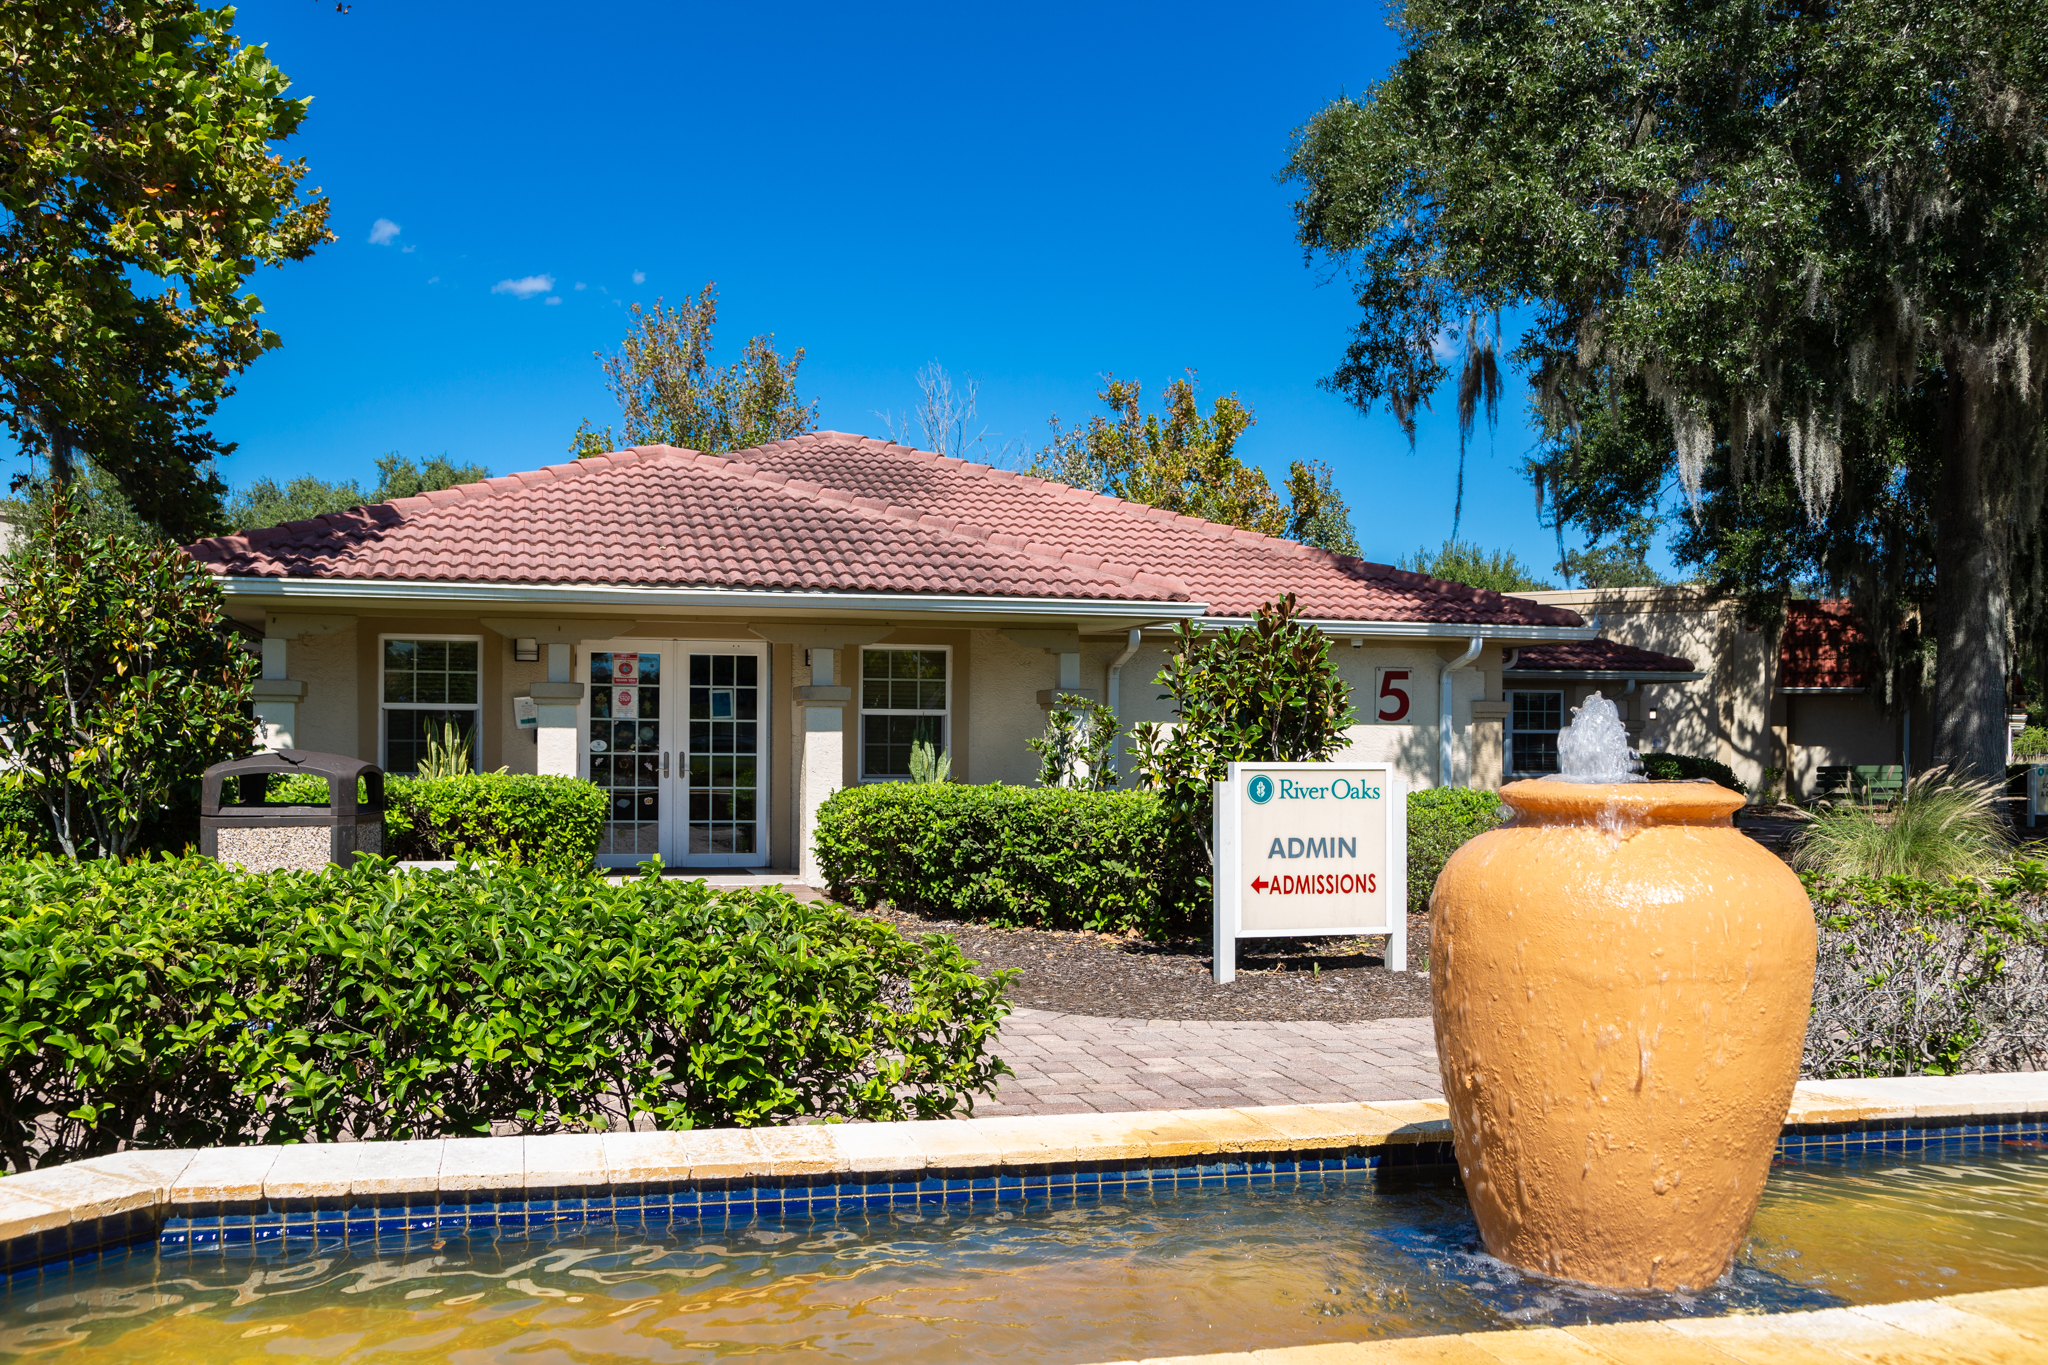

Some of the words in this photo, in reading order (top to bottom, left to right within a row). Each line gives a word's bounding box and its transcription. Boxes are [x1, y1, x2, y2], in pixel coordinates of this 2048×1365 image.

[1378, 670, 1410, 722] 5
[1278, 778, 1329, 800] River
[1331, 778, 1381, 800] Oaks
[1267, 836, 1357, 859] ADMIN
[1269, 873, 1377, 895] ADMISSIONS
